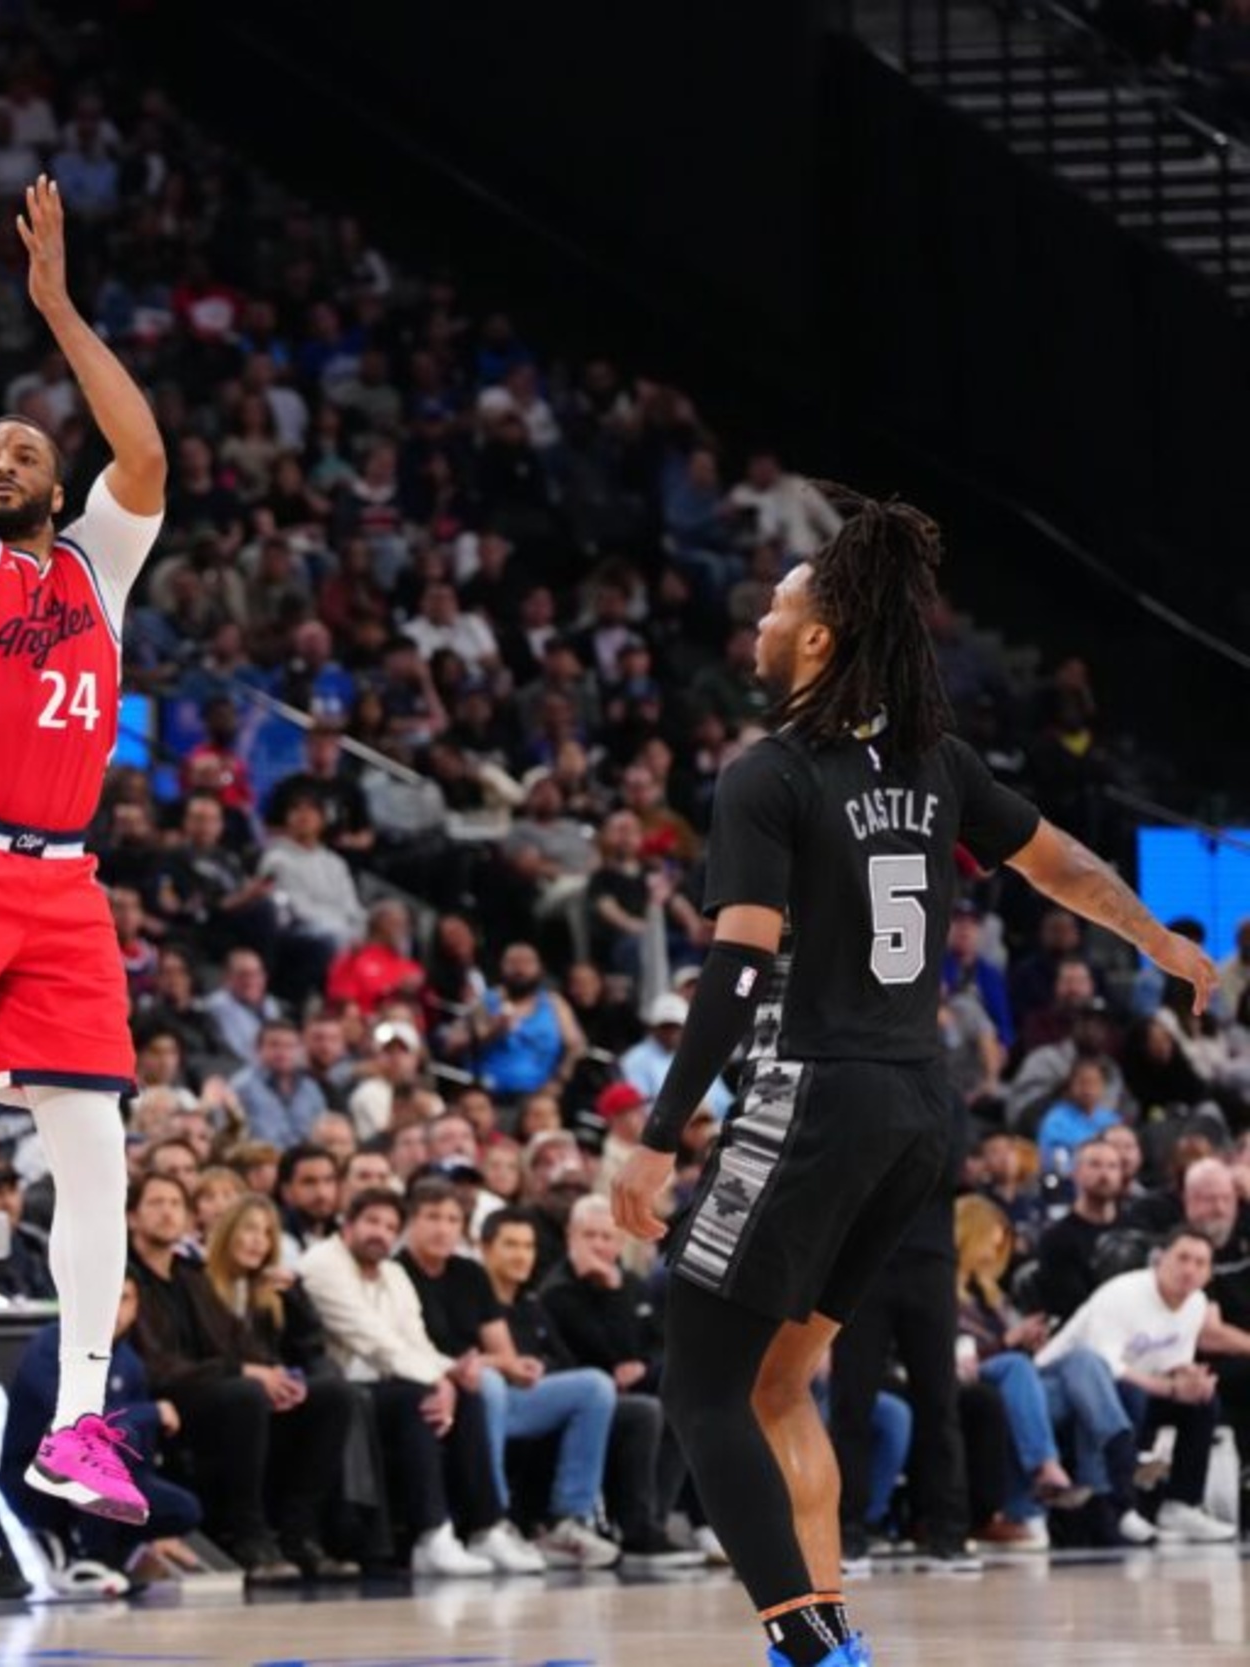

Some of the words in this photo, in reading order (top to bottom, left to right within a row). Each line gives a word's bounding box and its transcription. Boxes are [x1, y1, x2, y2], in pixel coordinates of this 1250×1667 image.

[38, 670, 101, 731] 24
[846, 788, 938, 840] CASTLE
[868, 853, 928, 985] 5
